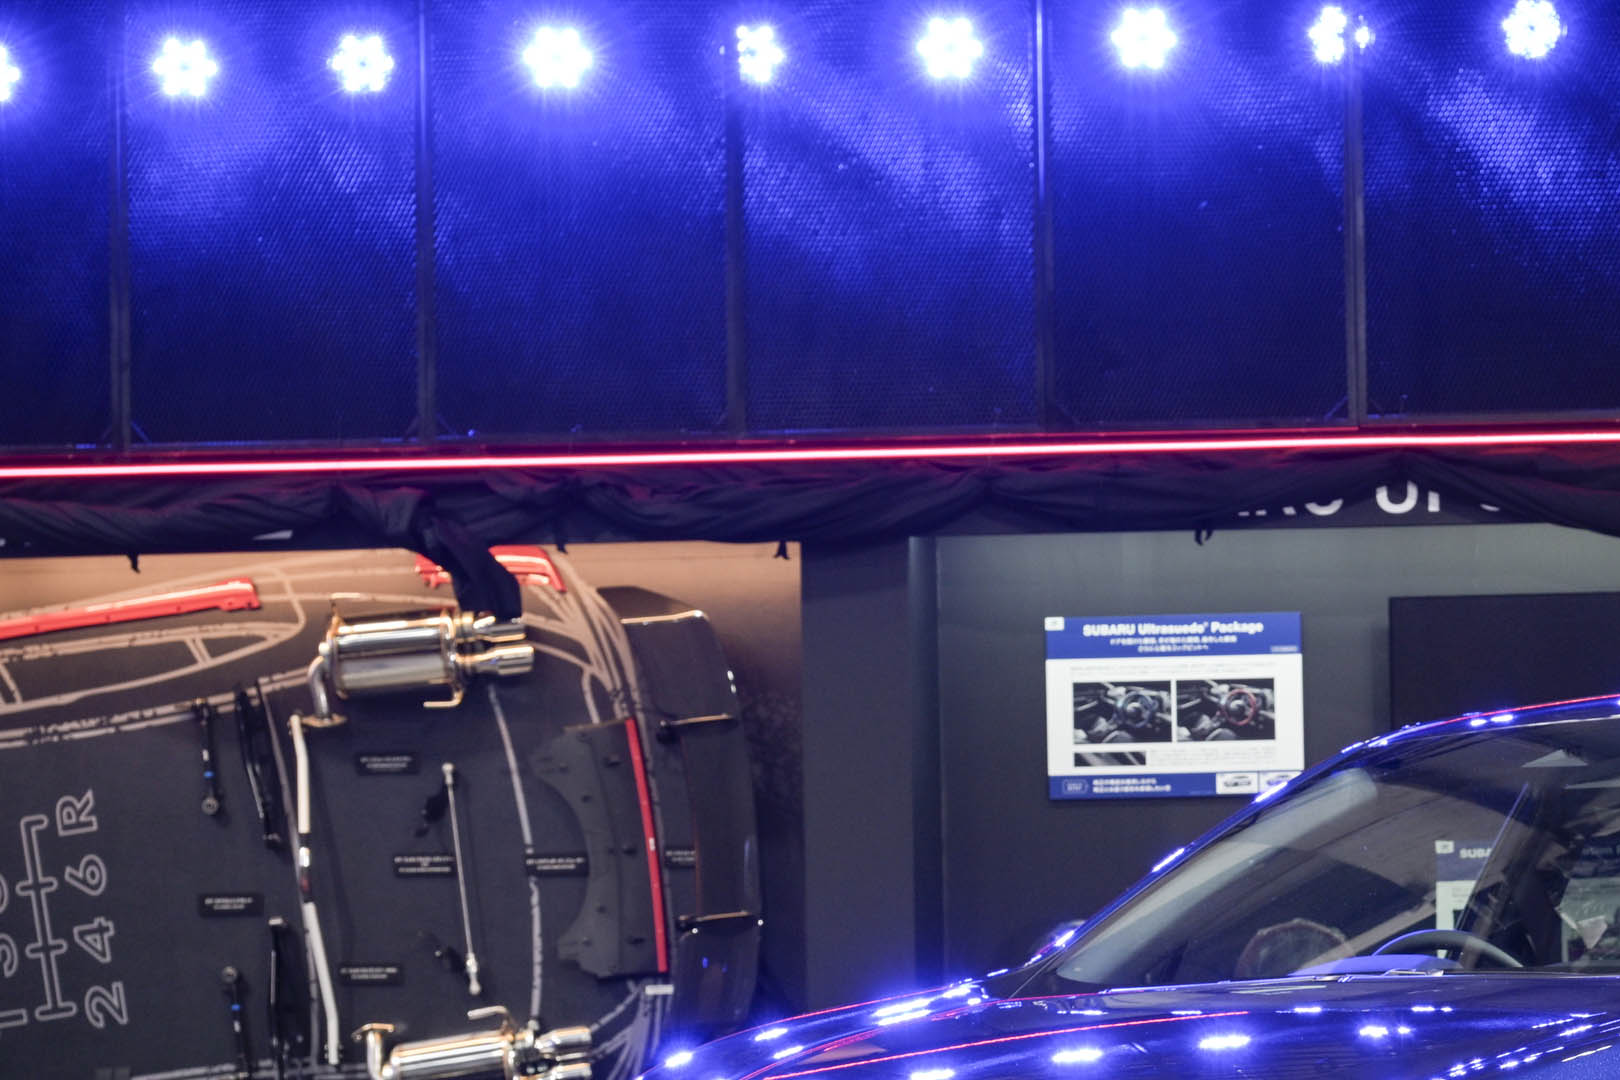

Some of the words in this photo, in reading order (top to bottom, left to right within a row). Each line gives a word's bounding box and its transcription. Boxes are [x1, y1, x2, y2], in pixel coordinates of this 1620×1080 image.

[1082, 623, 1136, 637] SUBARU
[1210, 621, 1264, 635] Package
[56, 788, 98, 837] R
[65, 854, 107, 896] 6
[73, 916, 115, 963] 4
[84, 981, 128, 1028] 2
